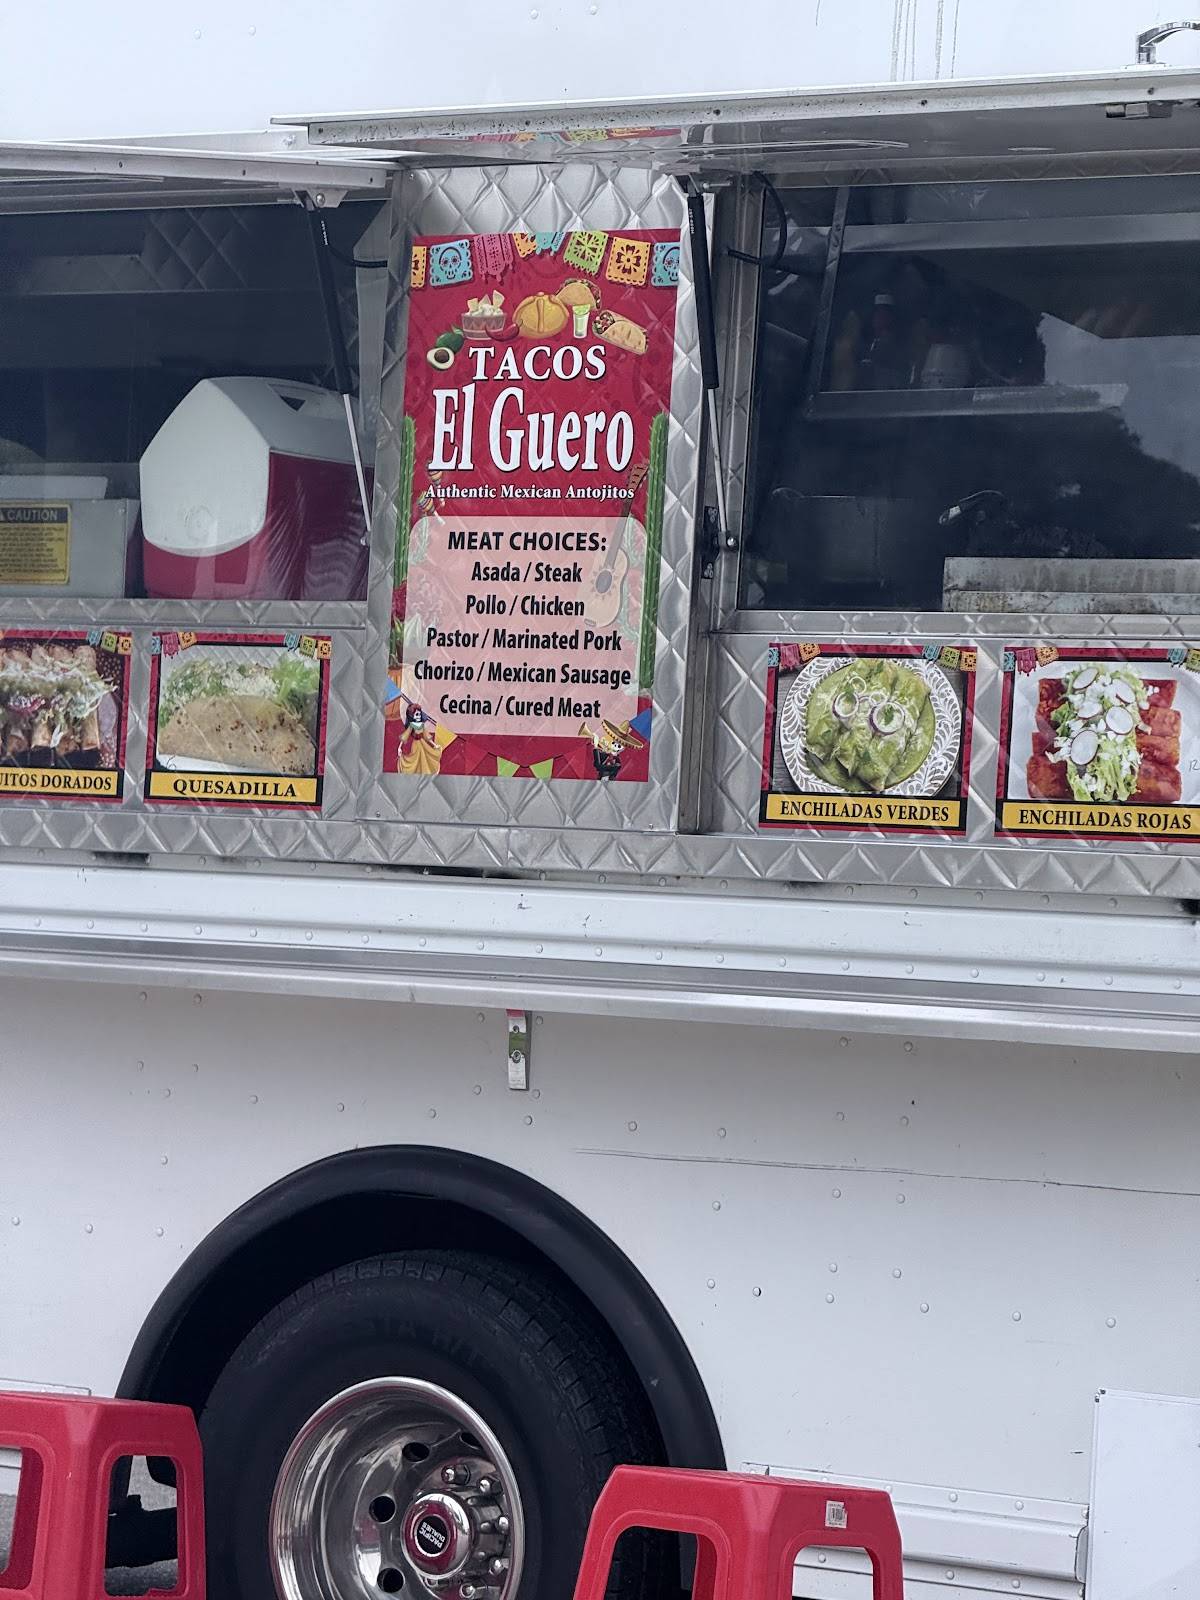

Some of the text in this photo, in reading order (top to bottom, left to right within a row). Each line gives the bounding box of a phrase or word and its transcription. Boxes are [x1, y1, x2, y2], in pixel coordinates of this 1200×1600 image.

[468, 344, 607, 381] TACOS
[427, 382, 635, 473] El Guero
[425, 484, 635, 503] Authentic Mexican Antojitos
[7, 510, 58, 521] CAUTION
[448, 531, 607, 552] MEAT CHOICES:
[471, 561, 583, 583] Asada / Steak
[466, 595, 585, 616] Pollo / Chicken
[427, 627, 622, 651] Pastor / Marinated Pork
[414, 660, 632, 690] Chorizo / Mexican Sausage
[439, 694, 602, 718] Cecina / Cured Meat
[40, 773, 112, 791] DORADOS
[173, 778, 297, 798] QUESADILLA
[780, 800, 949, 821] ENCHILADAS VERDES
[1019, 809, 1192, 831] ENCHILADAS ROJAS
[418, 1527, 443, 1549] PACIFIC
